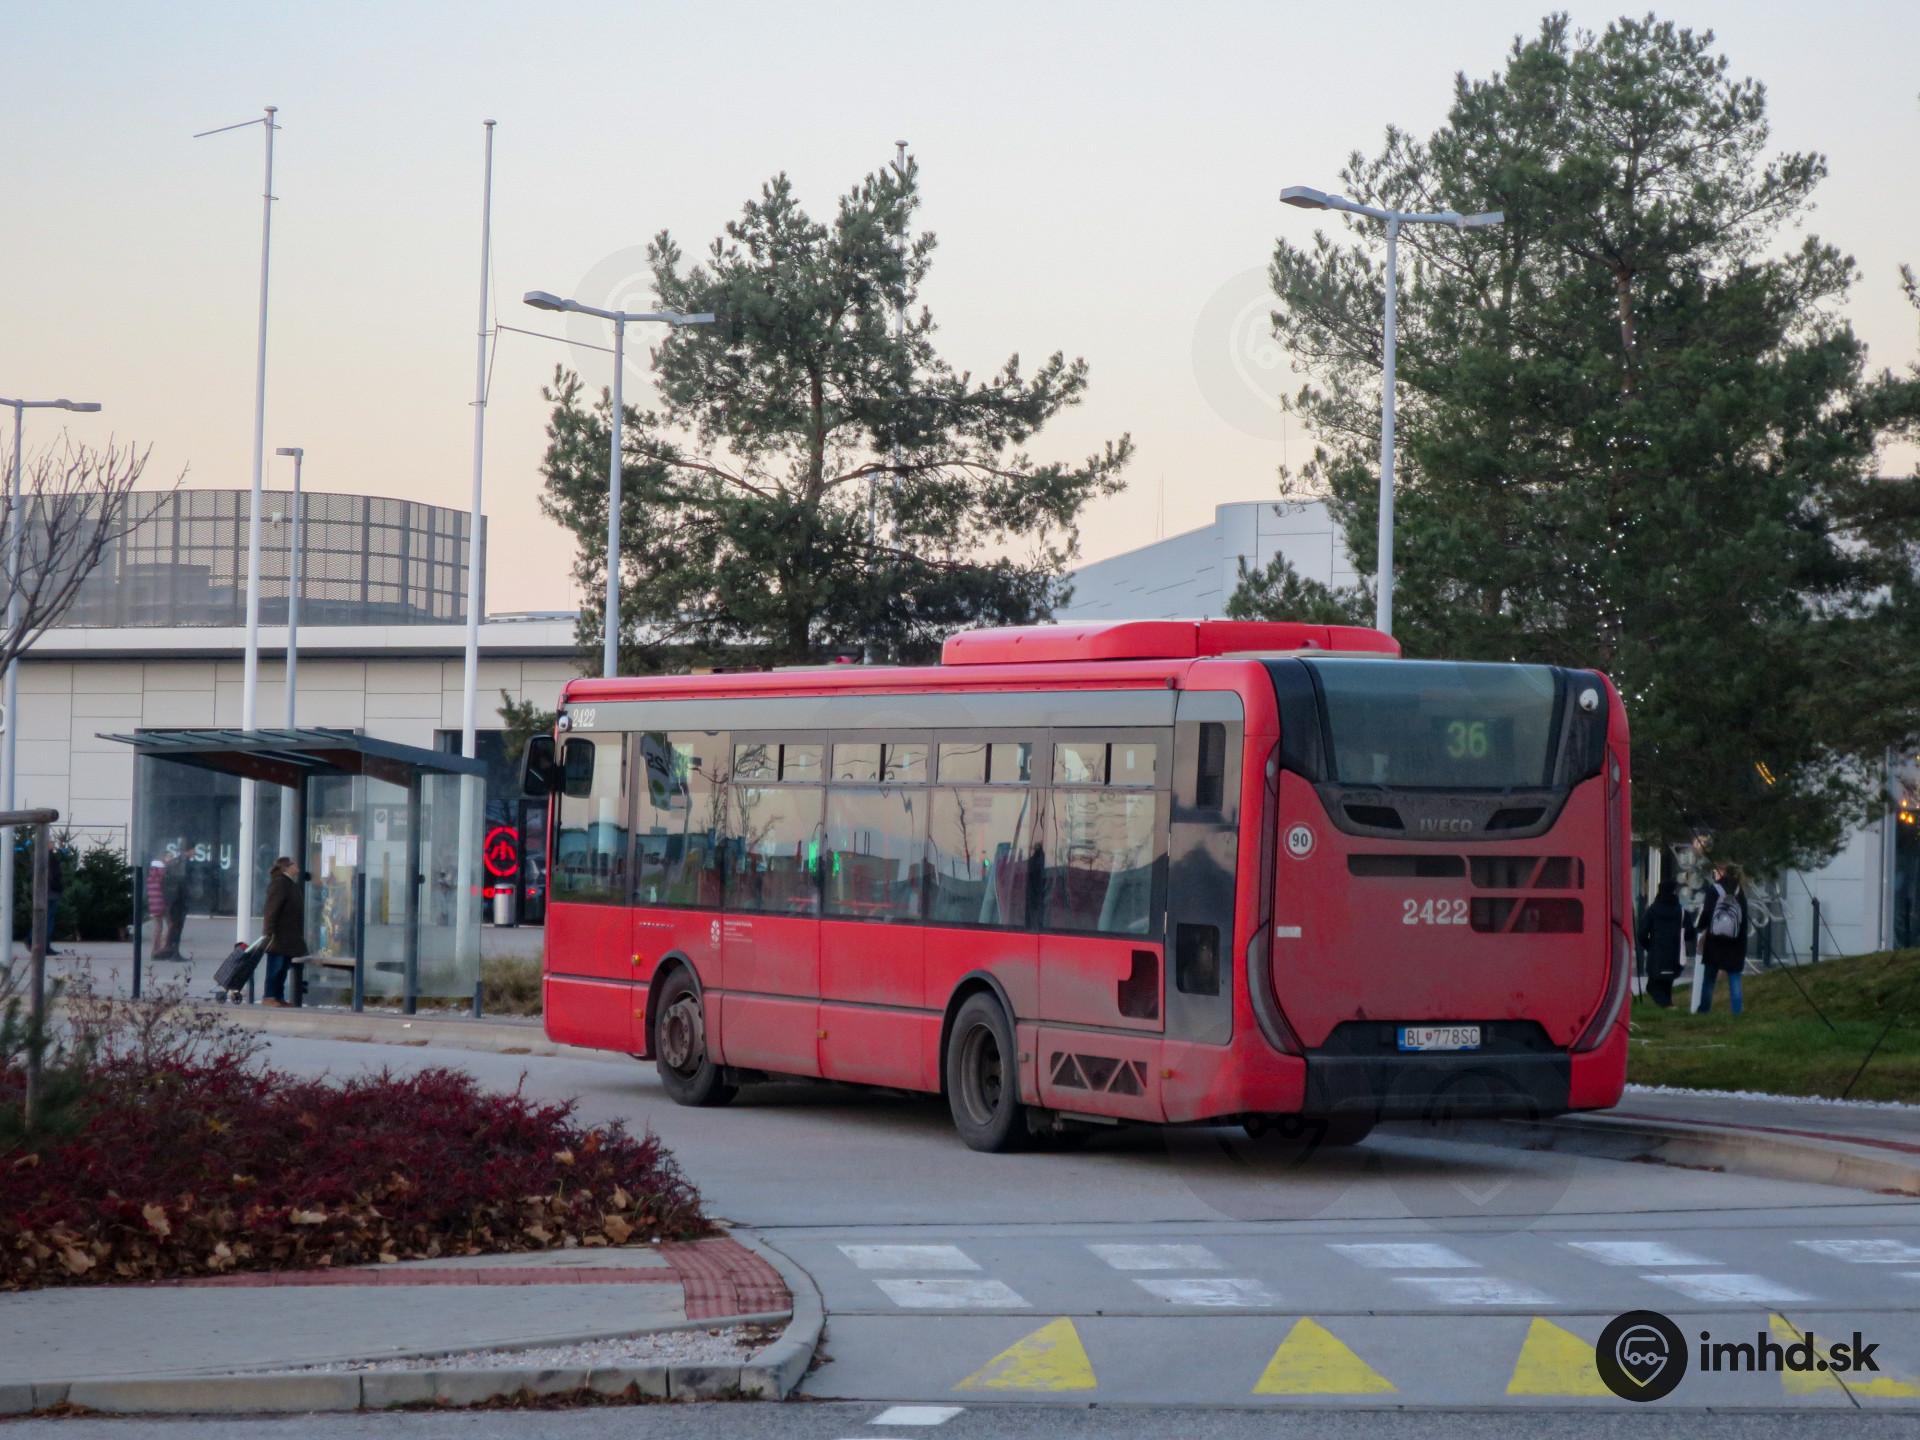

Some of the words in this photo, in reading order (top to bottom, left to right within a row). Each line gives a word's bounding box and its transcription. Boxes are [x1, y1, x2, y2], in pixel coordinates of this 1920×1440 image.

[572, 708, 596, 728] 2422
[1447, 721, 1488, 758] 36
[1420, 818, 1473, 833] IVECO
[1292, 833, 1309, 848] 90
[1402, 899, 1468, 925] 2422
